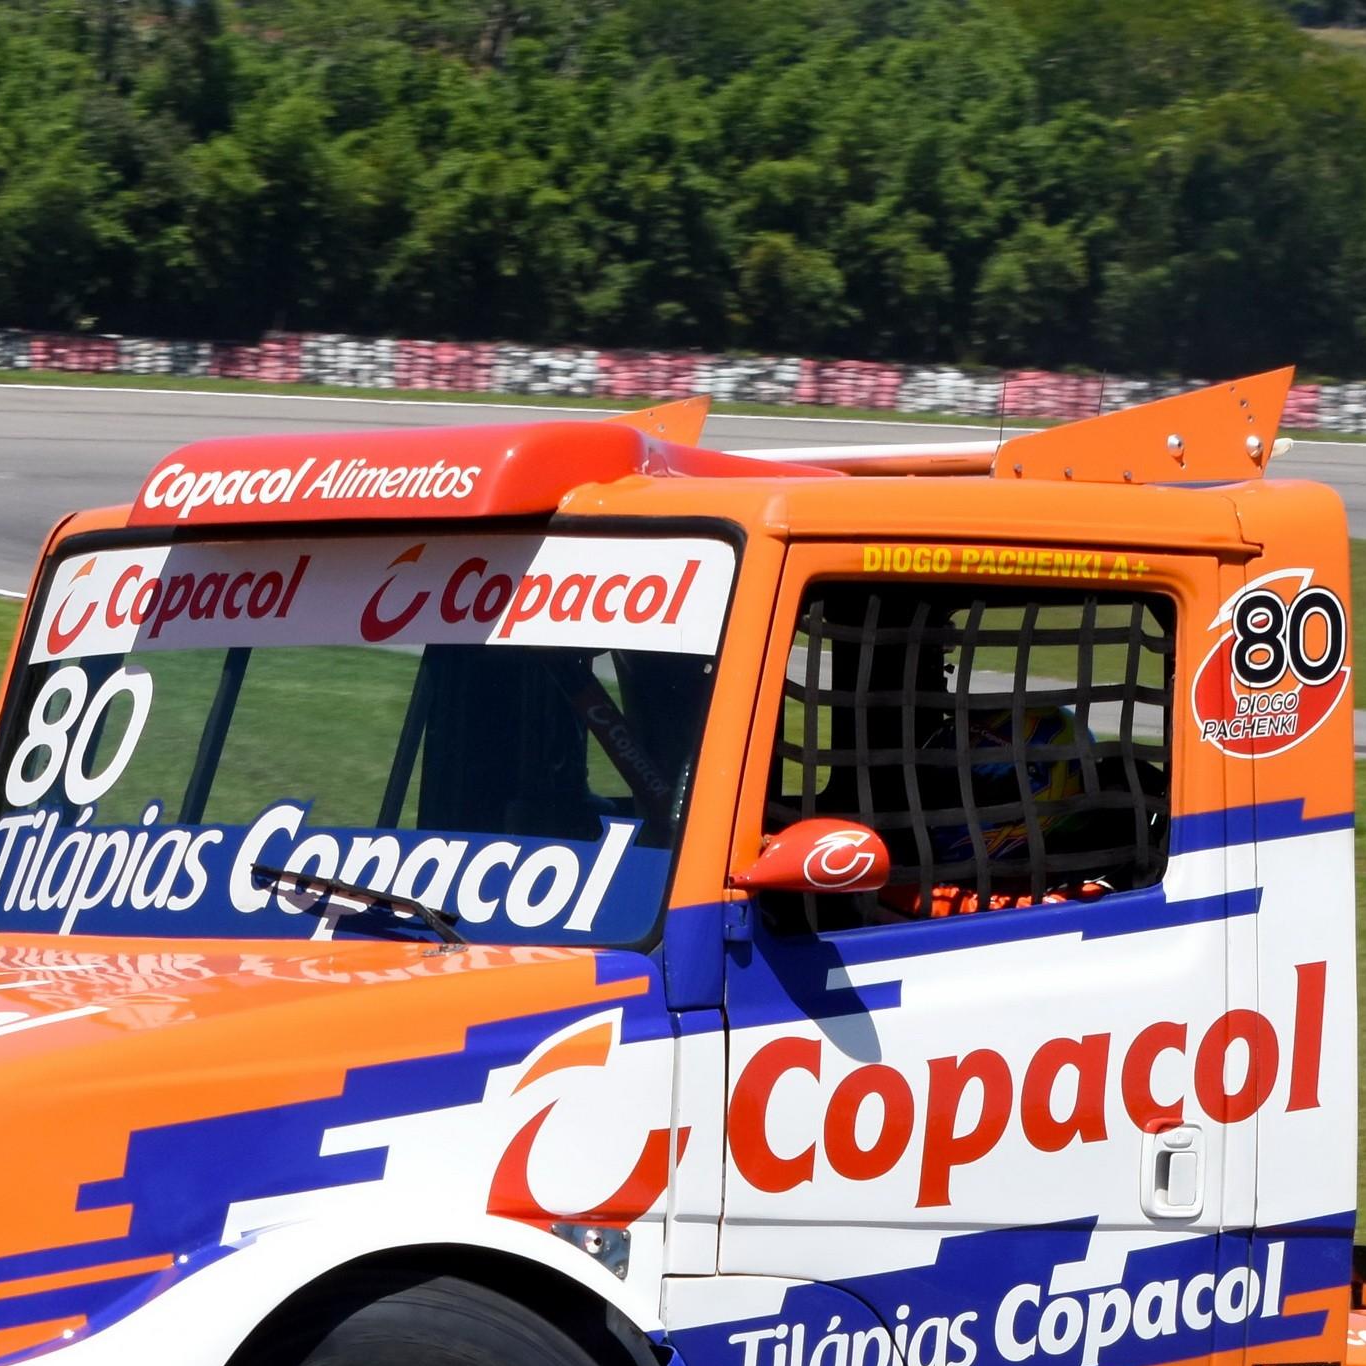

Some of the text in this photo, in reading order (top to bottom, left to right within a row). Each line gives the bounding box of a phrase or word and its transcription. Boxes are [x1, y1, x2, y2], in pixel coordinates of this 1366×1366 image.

[143, 457, 481, 518] Copacol Alimentos
[105, 555, 309, 639] Copacol
[440, 558, 701, 640] Copacol
[863, 546, 1150, 580] DIOGO PACHENKI A+
[1231, 586, 1348, 690] 80
[5, 665, 154, 806] 80
[1201, 714, 1299, 741] PACHENKI
[1235, 692, 1299, 716] DIOGO
[229, 802, 637, 941] Copacol
[727, 960, 1327, 1208] Copacol
